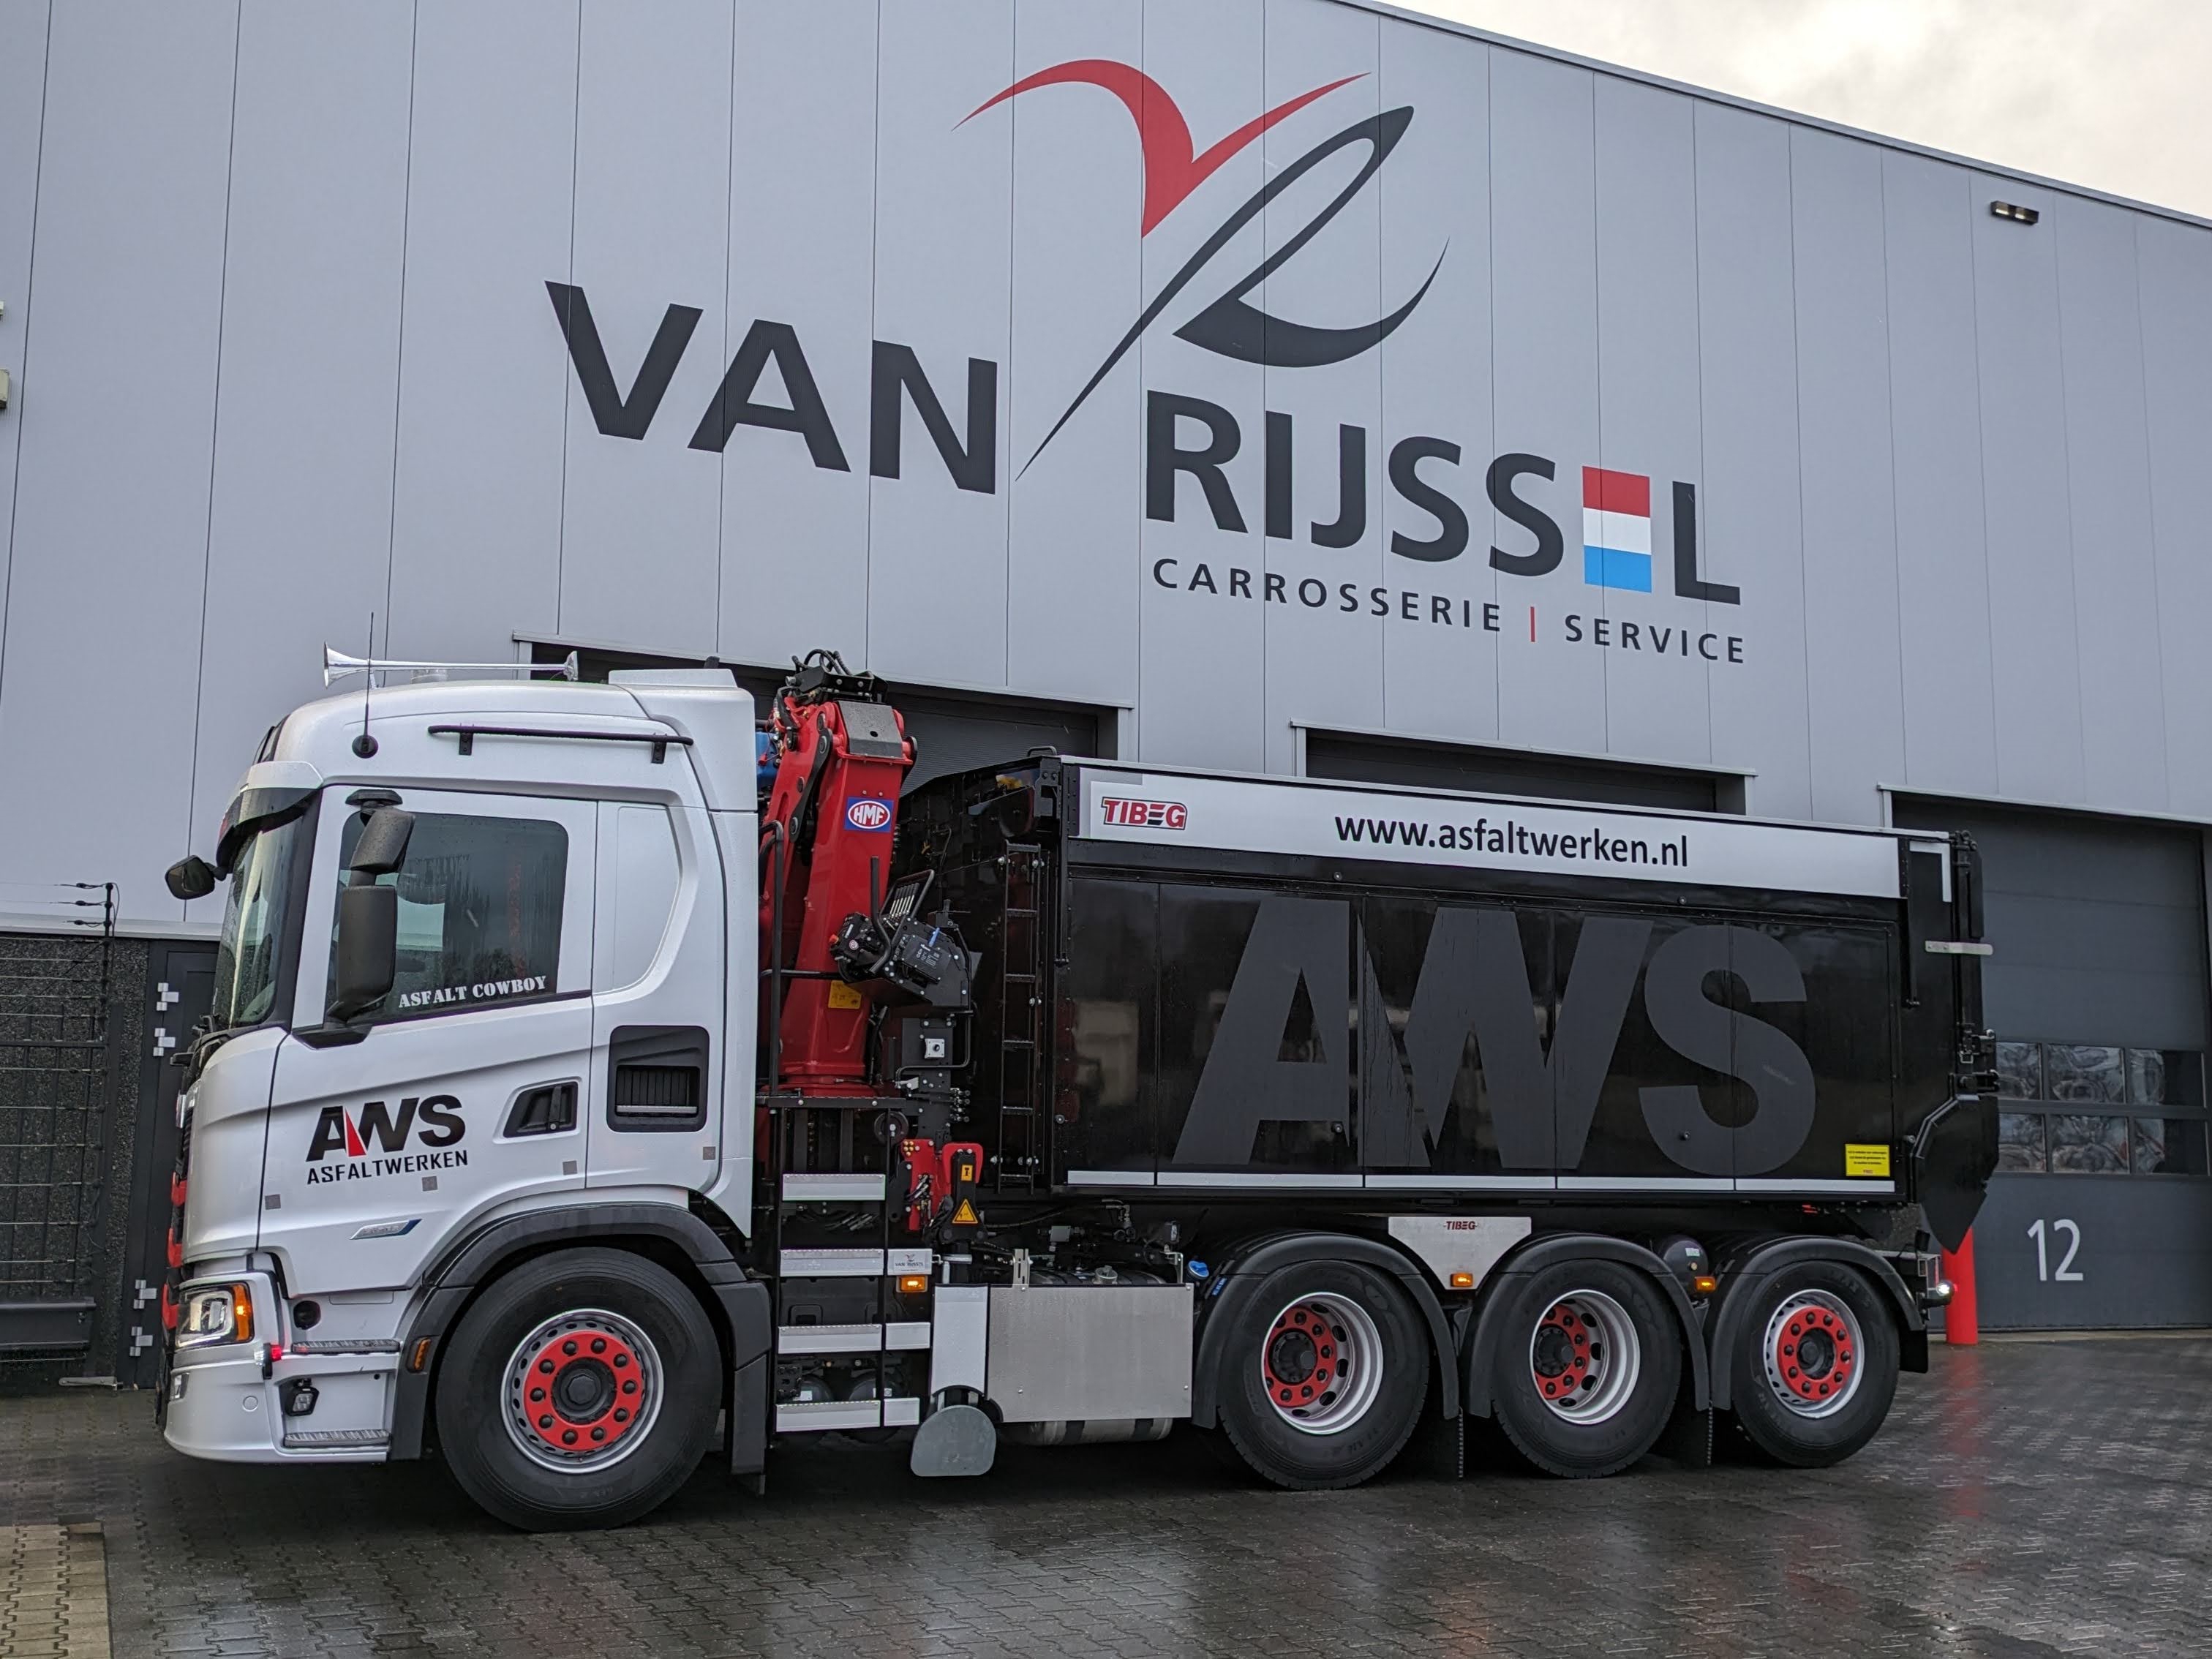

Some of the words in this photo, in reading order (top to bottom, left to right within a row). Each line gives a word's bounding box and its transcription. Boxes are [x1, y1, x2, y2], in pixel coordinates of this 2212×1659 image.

[544, 280, 998, 495] VAN
[1153, 557, 1501, 632] CARROSSERIE
[1565, 614, 1744, 664] SERVICE
[853, 804, 885, 826] HMF
[1103, 799, 1186, 828] TIBEG
[1334, 816, 1688, 868] www.asfaltwerken.nl
[399, 986, 467, 1008] ASFALT
[473, 975, 546, 998] COWBOY
[1172, 898, 1816, 1176] AWS
[305, 1094, 467, 1162] AWS
[307, 1149, 468, 1185] ASFALTWERKEN
[1445, 1221, 1476, 1230] TIBEG
[2027, 1219, 2084, 1282] 12
